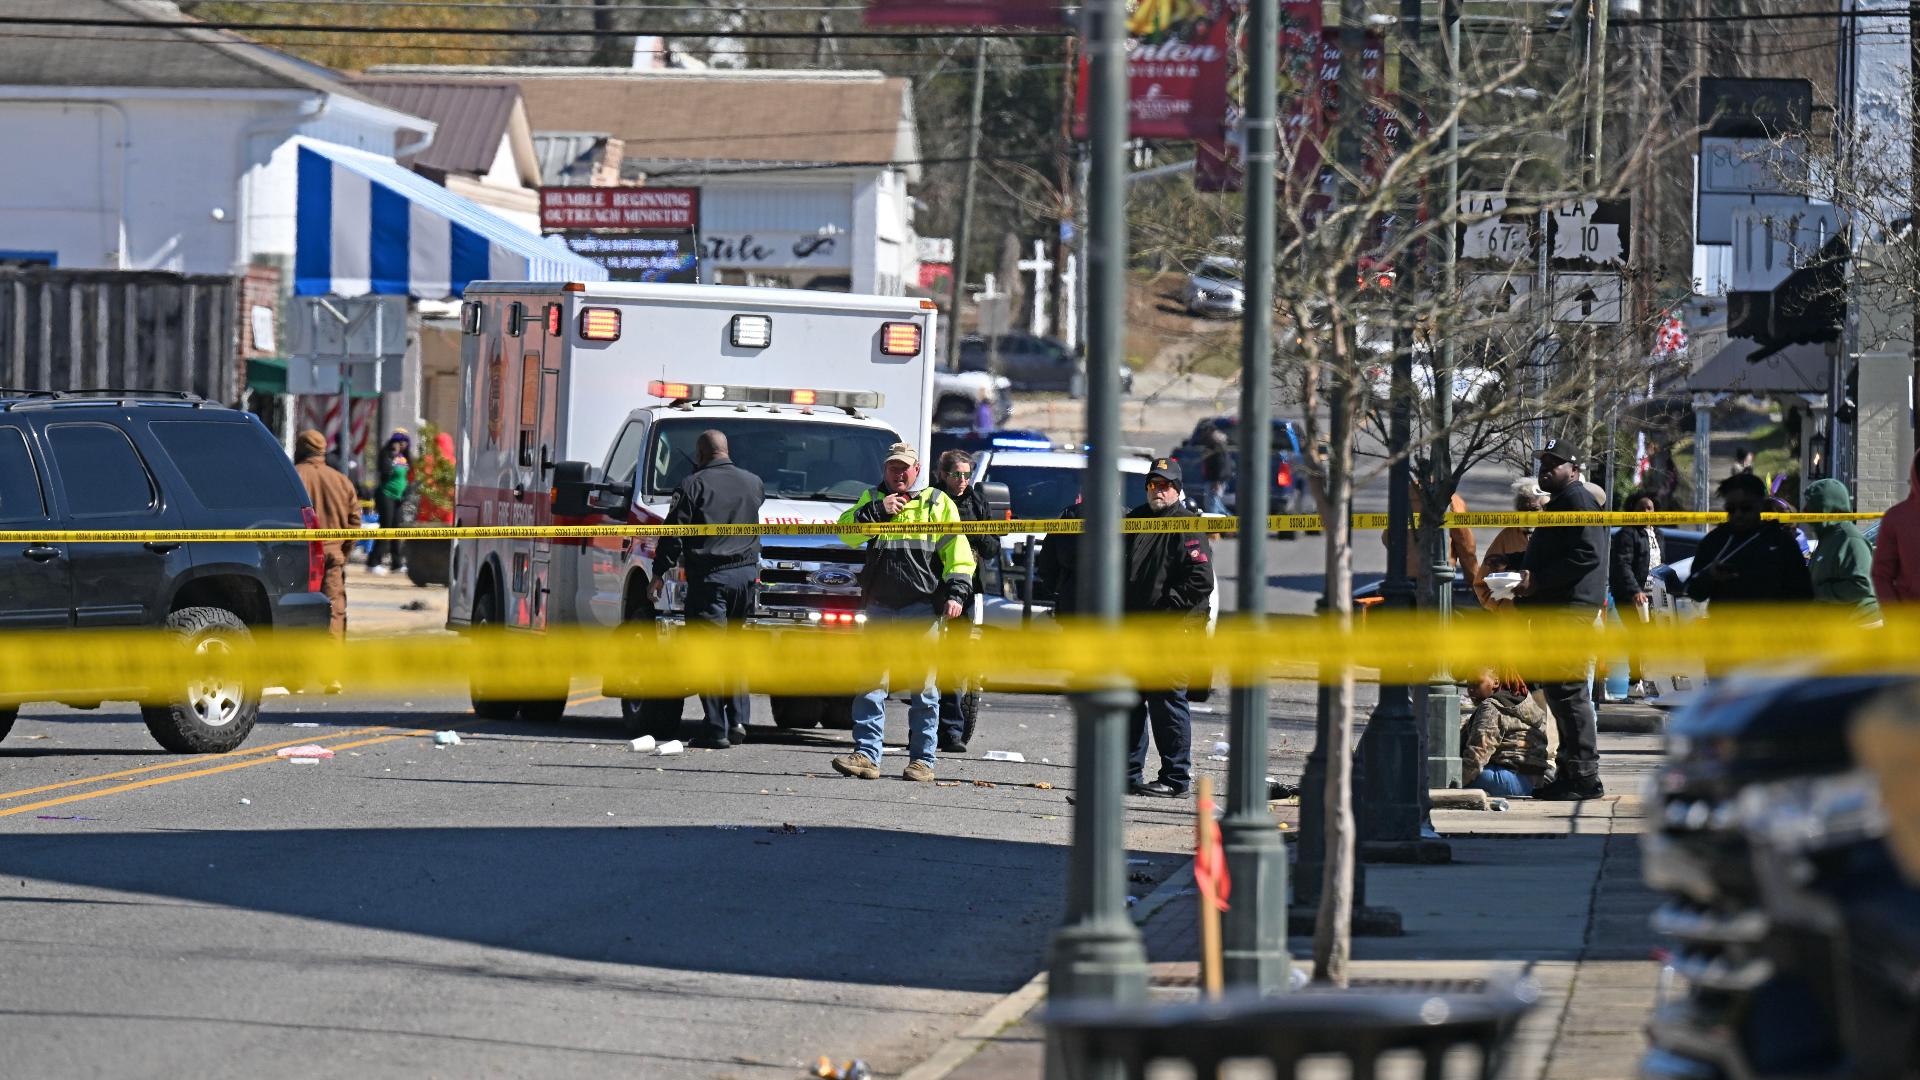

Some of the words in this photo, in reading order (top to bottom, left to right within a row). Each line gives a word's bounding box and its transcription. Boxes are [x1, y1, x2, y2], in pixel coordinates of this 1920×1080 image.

[545, 192, 605, 206] HUMBLE
[613, 192, 691, 207] BEGINNING
[1559, 198, 1586, 217] LA
[544, 208, 620, 222] OUTREACH
[623, 208, 690, 222] MINISTRY
[1581, 226, 1599, 252] 10
[1547, 439, 1557, 450] B
[1208, 519, 1224, 529] CROSS
[1224, 519, 1235, 529] NOT
[1290, 518, 1306, 528] CROSS
[1306, 518, 1316, 528] NOT
[1372, 516, 1388, 526] CROSS
[1454, 515, 1470, 525] CROSS
[1471, 515, 1481, 525] NOT
[1482, 515, 1490, 525] DO
[1490, 515, 1502, 525] LINE
[1502, 515, 1520, 525] POLICE
[1538, 514, 1554, 524] CROSS
[1554, 514, 1564, 524] NOT
[1566, 514, 1574, 524] DO
[1574, 514, 1584, 524] LINE
[1586, 514, 1604, 524] POLICE
[798, 525, 814, 534] CROSS
[814, 525, 824, 534] NOT
[825, 525, 832, 534] DO
[834, 525, 845, 534] LINE
[846, 525, 862, 534] POLICE
[880, 524, 896, 533] CROSS
[896, 524, 906, 533] NOT
[906, 524, 914, 533] DO
[915, 524, 925, 533] LINE
[926, 524, 944, 533] POLICE
[961, 524, 978, 532] CROSS
[979, 524, 988, 532] NOT
[988, 524, 996, 532] DO
[998, 524, 1008, 532] LINE
[1009, 524, 1025, 532] POLICE
[1044, 522, 1060, 532] CROSS
[1060, 522, 1070, 532] NOT
[1070, 522, 1078, 532] DO
[1124, 520, 1142, 530] CROSS
[1142, 520, 1152, 530] NOT
[1152, 520, 1160, 530] DO
[1161, 520, 1172, 530] LINE
[1172, 520, 1190, 530] POLICE
[636, 528, 651, 536] CROSS
[652, 528, 662, 536] NOT
[662, 528, 670, 536] DO
[670, 528, 682, 536] LINE
[682, 528, 698, 536] POLICE
[716, 526, 732, 535] CROSS
[732, 526, 742, 535] NOT
[742, 526, 750, 535] DO
[752, 526, 762, 535] LINE
[764, 526, 780, 535] POLICE
